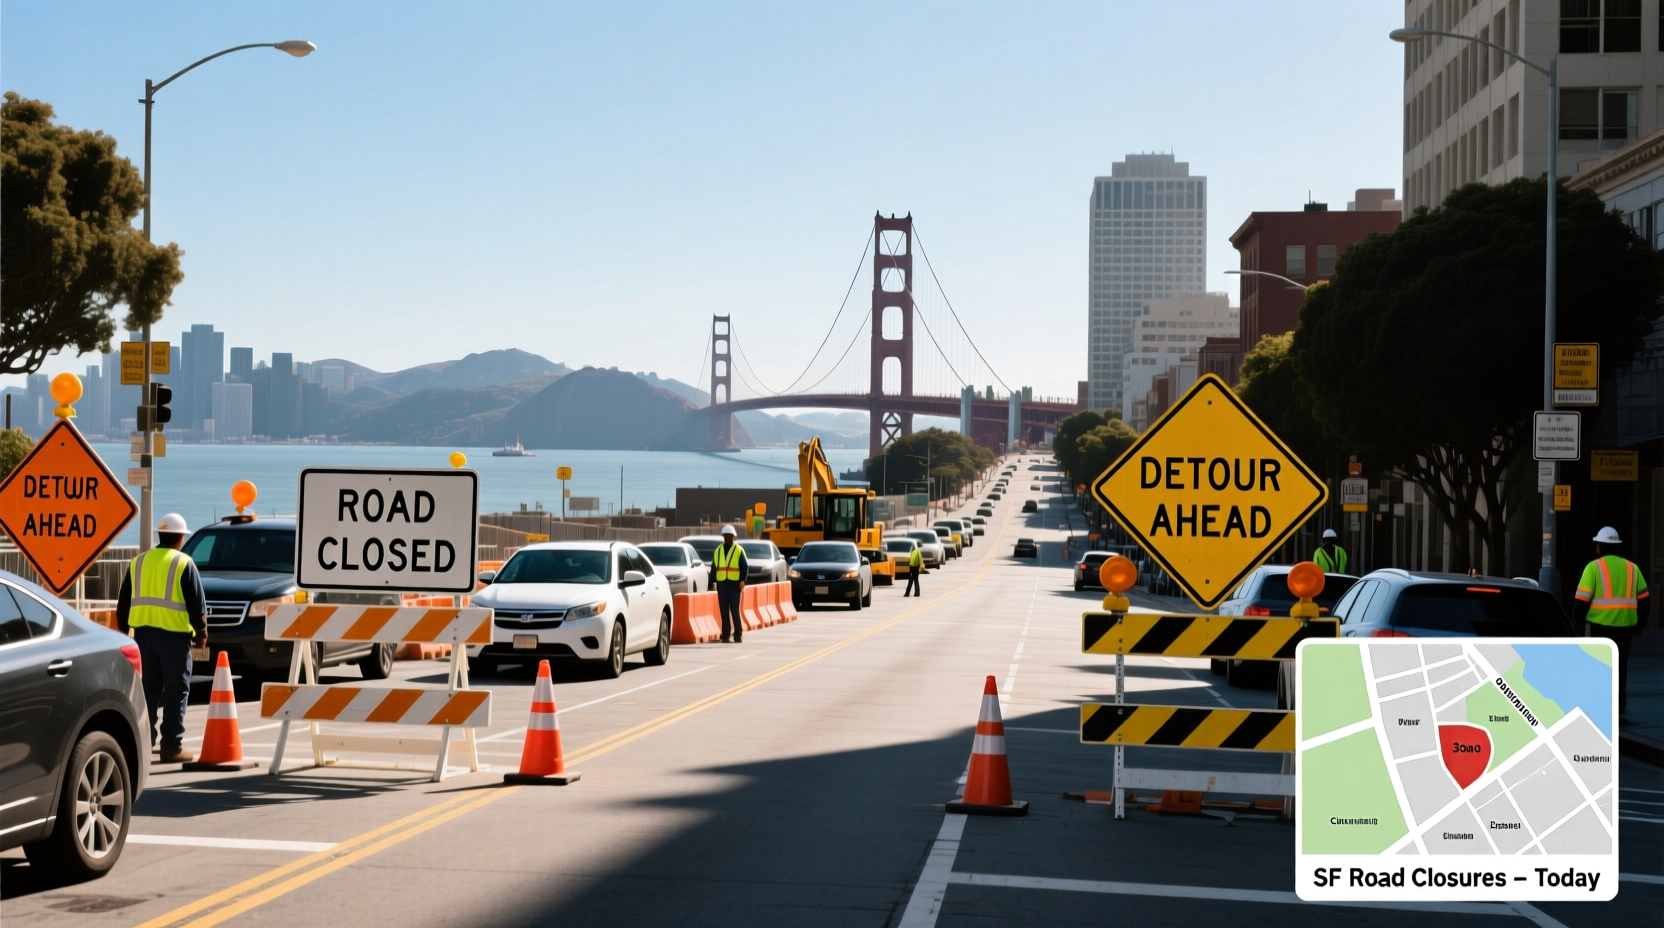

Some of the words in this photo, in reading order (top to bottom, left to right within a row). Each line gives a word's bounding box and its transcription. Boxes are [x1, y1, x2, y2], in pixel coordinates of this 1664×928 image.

[1140, 456, 1282, 492] DETOUR
[338, 488, 436, 523] ROAD
[1149, 503, 1273, 539] AHEAD
[22, 513, 97, 538] AHEAD
[317, 536, 456, 573] CLOSED
